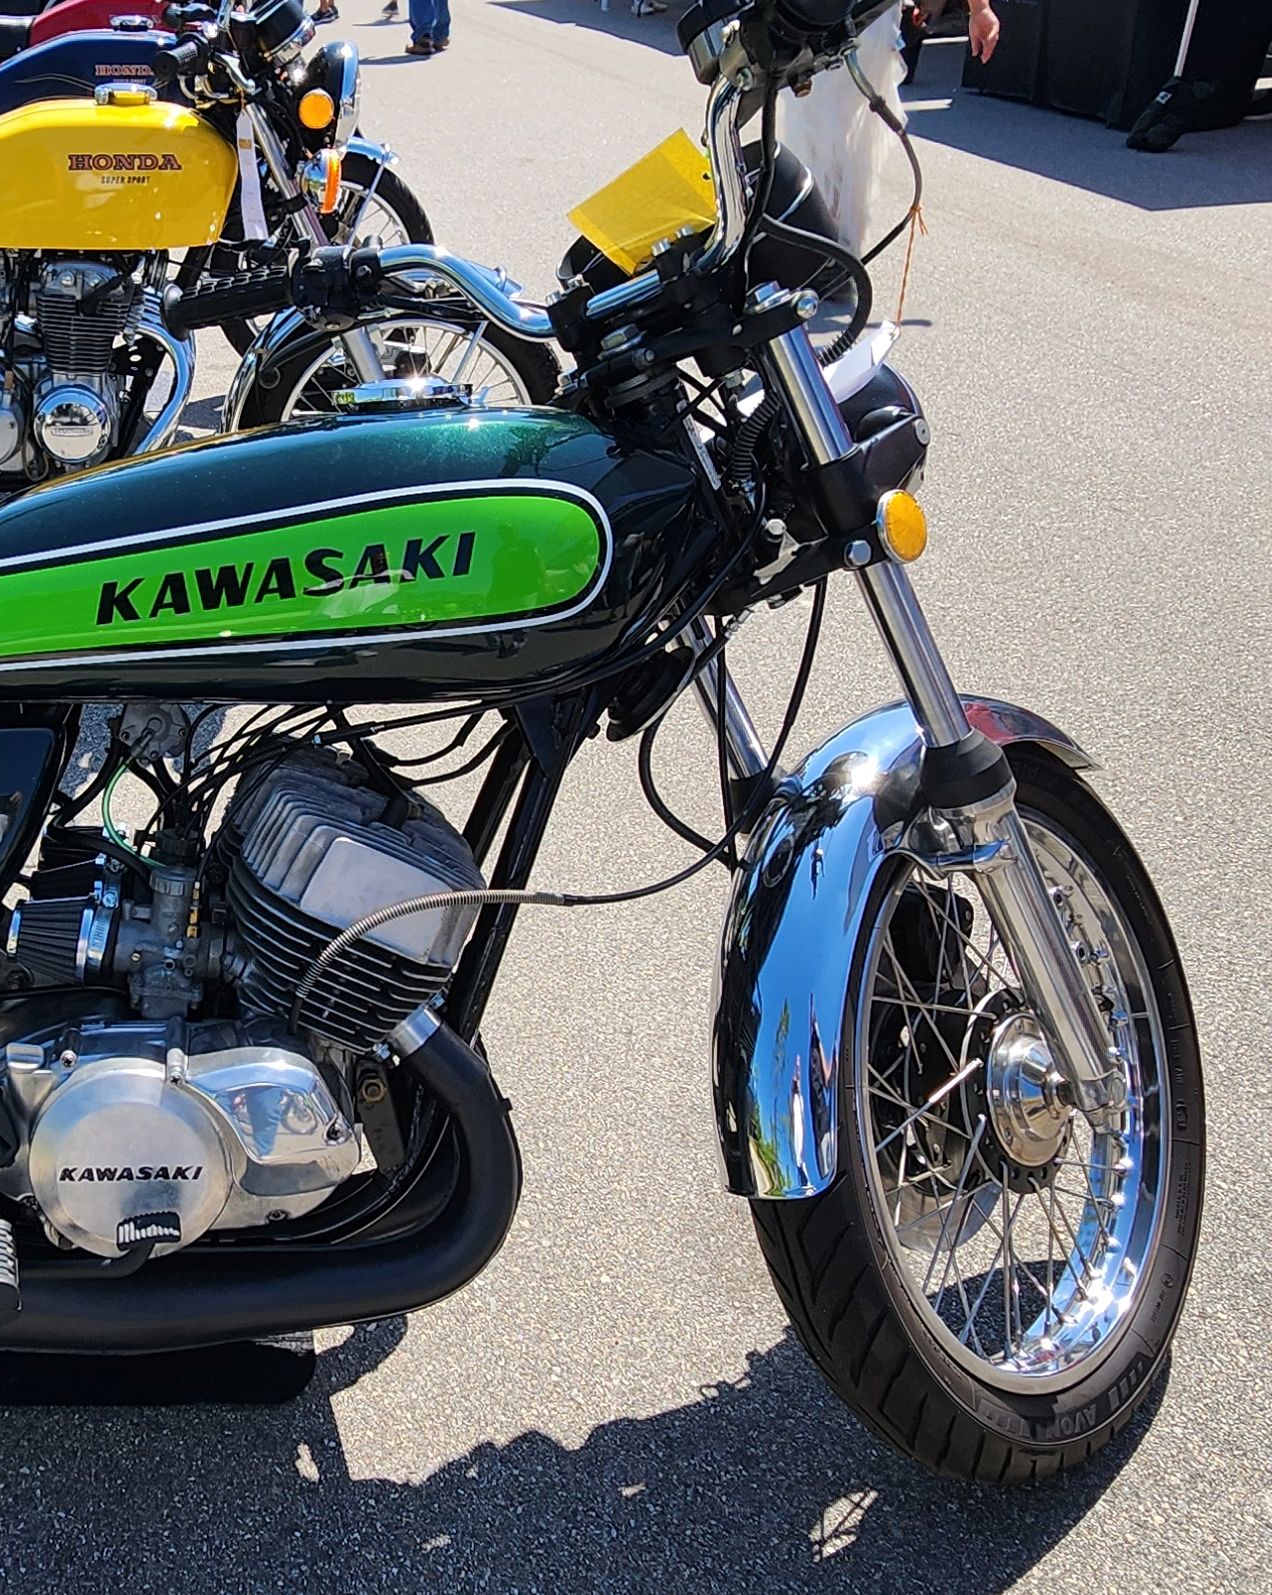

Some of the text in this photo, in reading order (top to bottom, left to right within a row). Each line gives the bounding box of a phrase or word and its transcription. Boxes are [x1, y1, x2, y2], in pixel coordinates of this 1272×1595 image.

[95, 64, 155, 76] HOND
[67, 153, 183, 171] HONDA
[101, 175, 151, 185] SUPER SPORT
[95, 530, 477, 627] KAWASAKI
[58, 1165, 204, 1182] KAWASAKI
